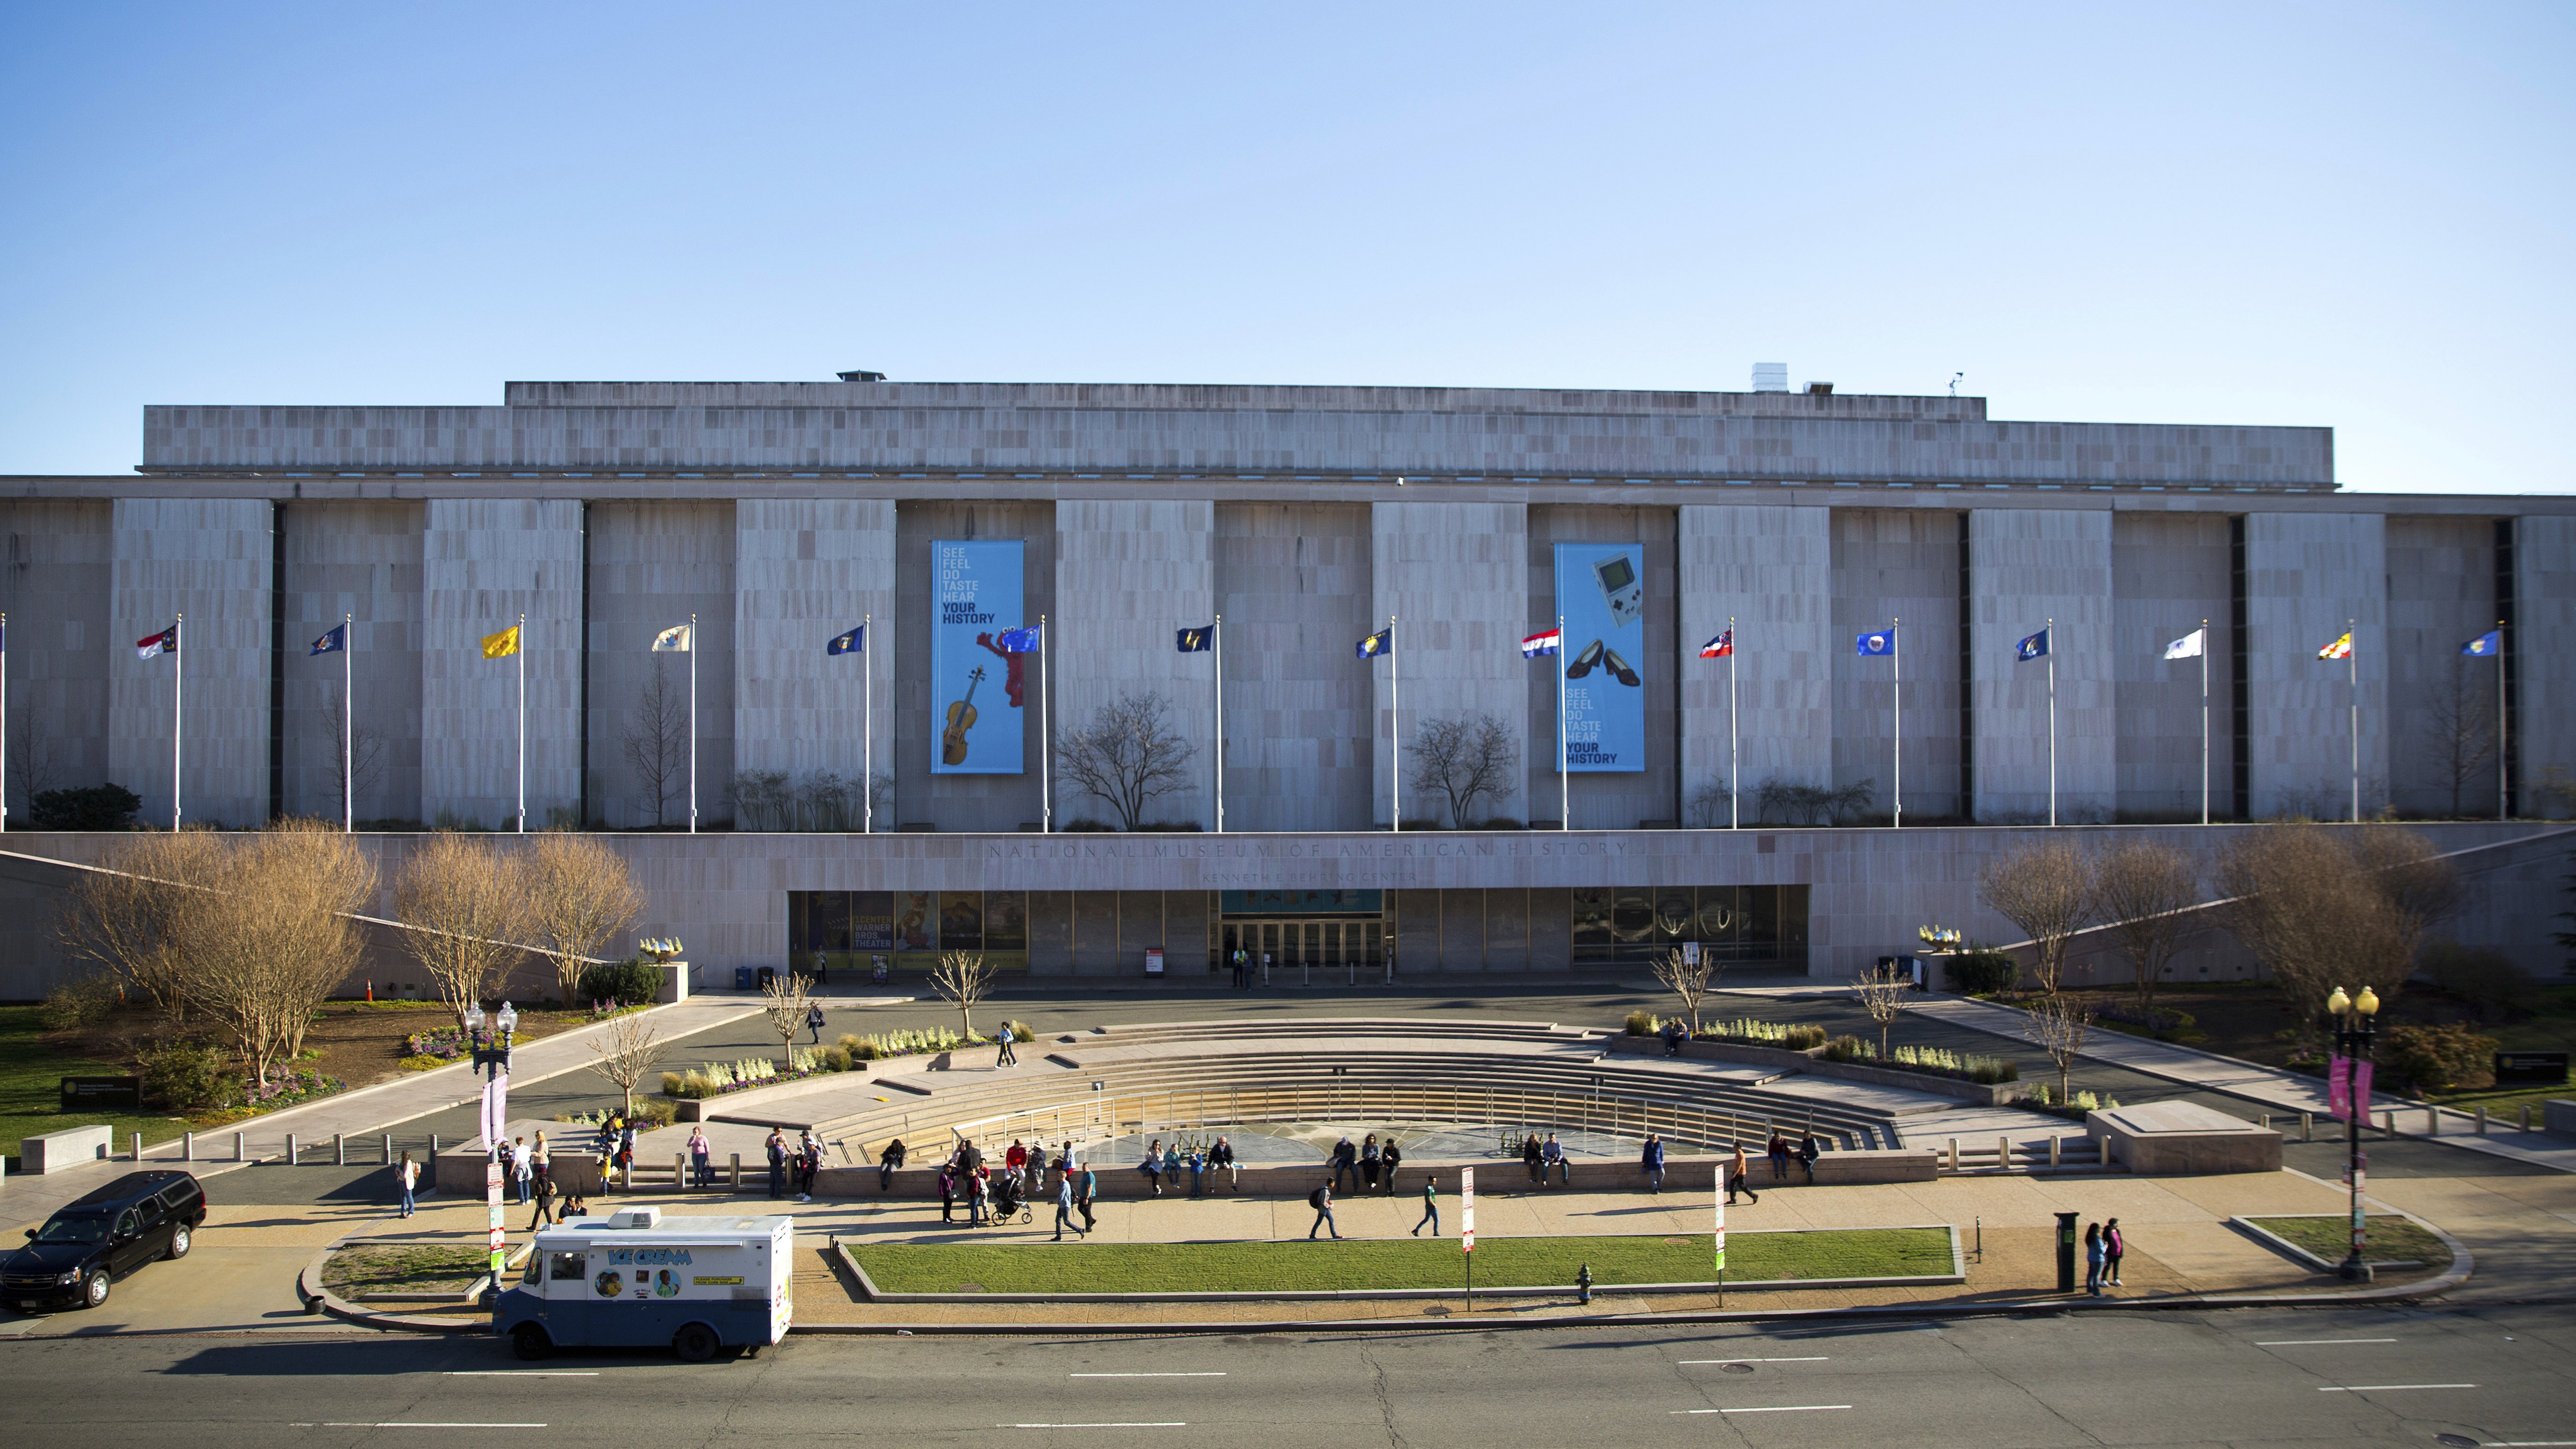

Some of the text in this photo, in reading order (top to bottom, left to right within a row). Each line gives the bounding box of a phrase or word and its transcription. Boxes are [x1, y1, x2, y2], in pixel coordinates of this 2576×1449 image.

[943, 547, 965, 558] SEE
[943, 558, 970, 569] FEEL
[943, 569, 959, 580] DO
[942, 580, 979, 591] TASTE
[943, 591, 975, 602] HEAR
[943, 602, 976, 613] YOUR
[943, 613, 995, 624] HISTORY
[1567, 688, 1588, 698] SEE
[1567, 699, 1594, 710] FEEL
[1567, 710, 1583, 720] DO
[1566, 721, 1601, 731] TASTE
[1567, 732, 1598, 742] HEAR
[1566, 742, 1599, 753] YOUR
[1567, 753, 1617, 764] HISTORY
[989, 842, 1628, 858] NATIONAL MUSEUM OF AMERICAN HISTORY
[1203, 873, 1269, 883] KENNETH
[1291, 873, 1355, 882] BEHRING
[1361, 872, 1417, 882] CENTER
[608, 1247, 692, 1266] ICE CREAM
